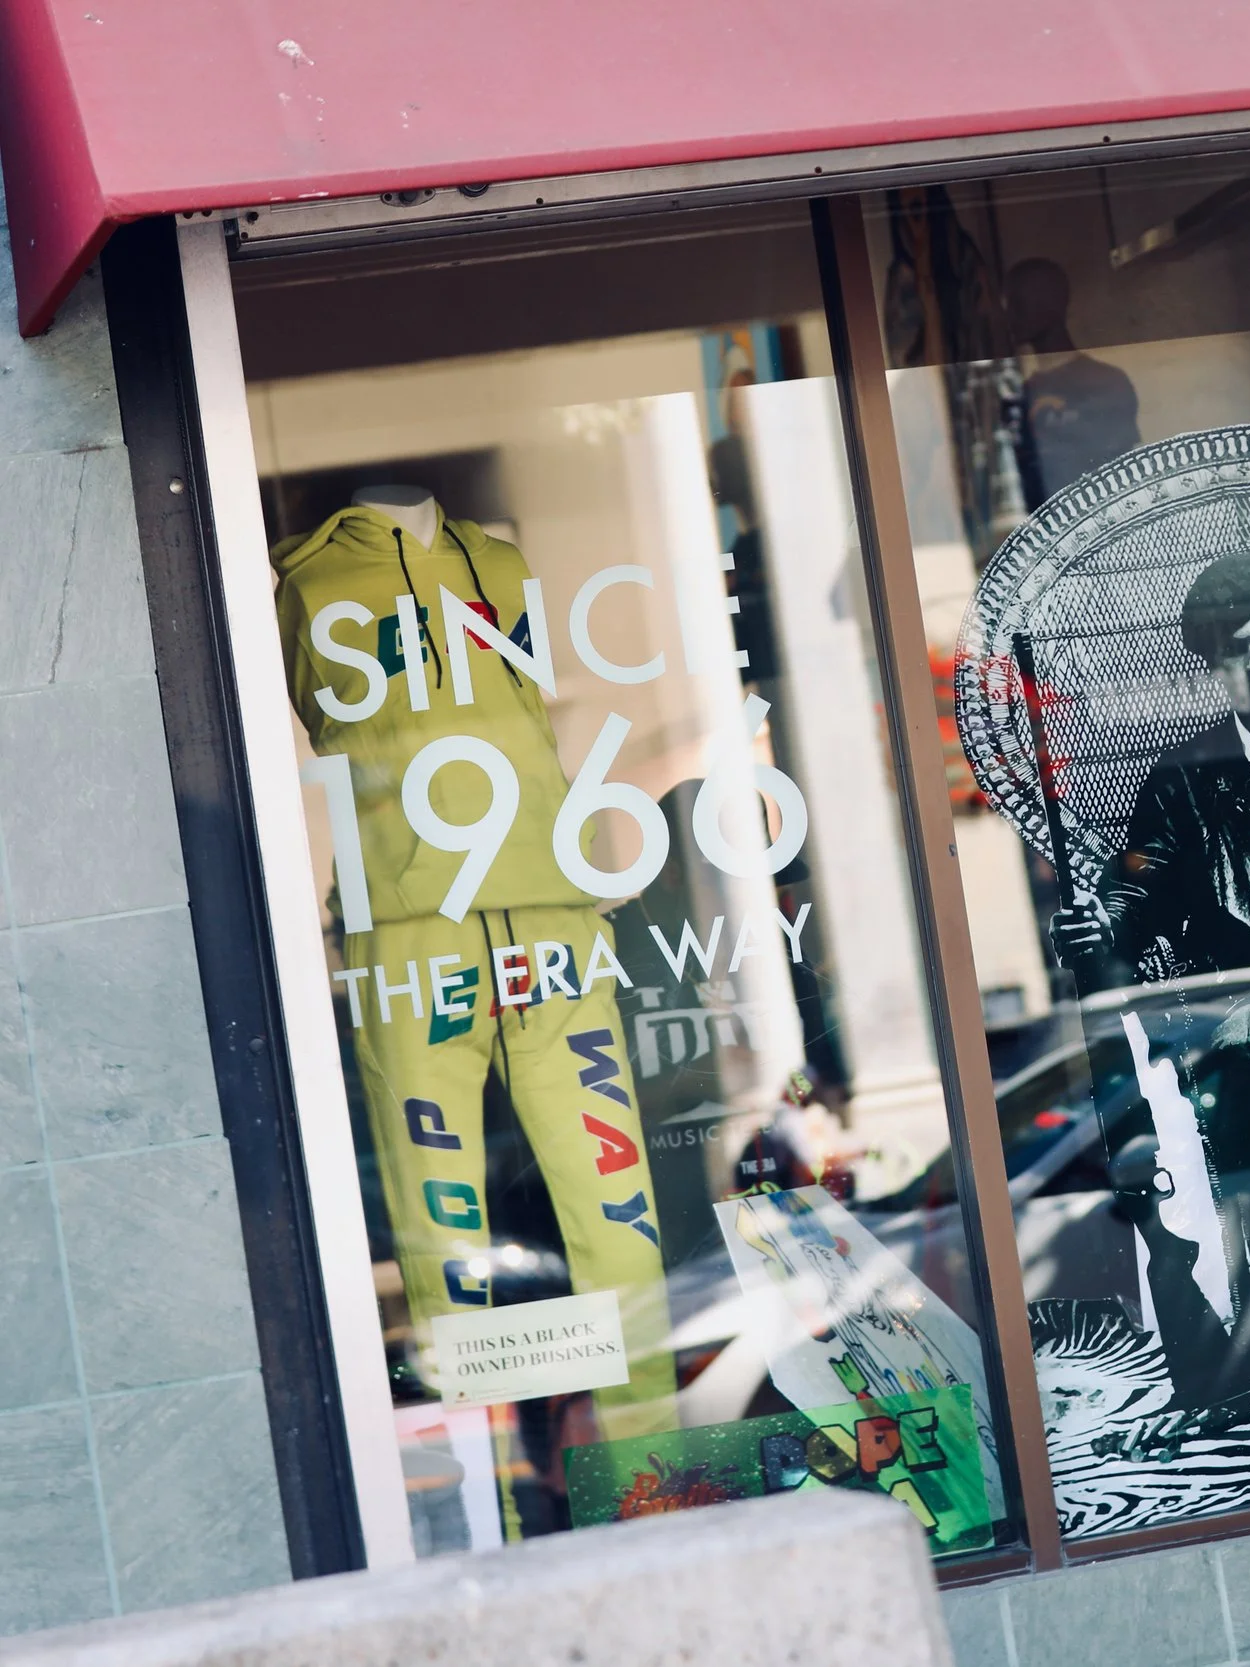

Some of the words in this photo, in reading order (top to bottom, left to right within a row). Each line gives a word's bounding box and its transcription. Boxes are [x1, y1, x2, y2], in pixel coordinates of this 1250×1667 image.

[310, 553, 750, 722] SINCE
[303, 692, 808, 934] 1966
[333, 953, 469, 1029] THE
[493, 931, 633, 1007] ERA
[648, 903, 812, 984] WAY
[650, 1125, 721, 1149] MUSIC
[453, 1336, 496, 1356] THIS
[500, 1333, 516, 1349] IS
[519, 1332, 533, 1346] A
[536, 1321, 598, 1344] BLACK
[457, 1354, 526, 1378] OWNED
[529, 1341, 621, 1367] BUSINESS.
[760, 1406, 948, 1493] DOPE
